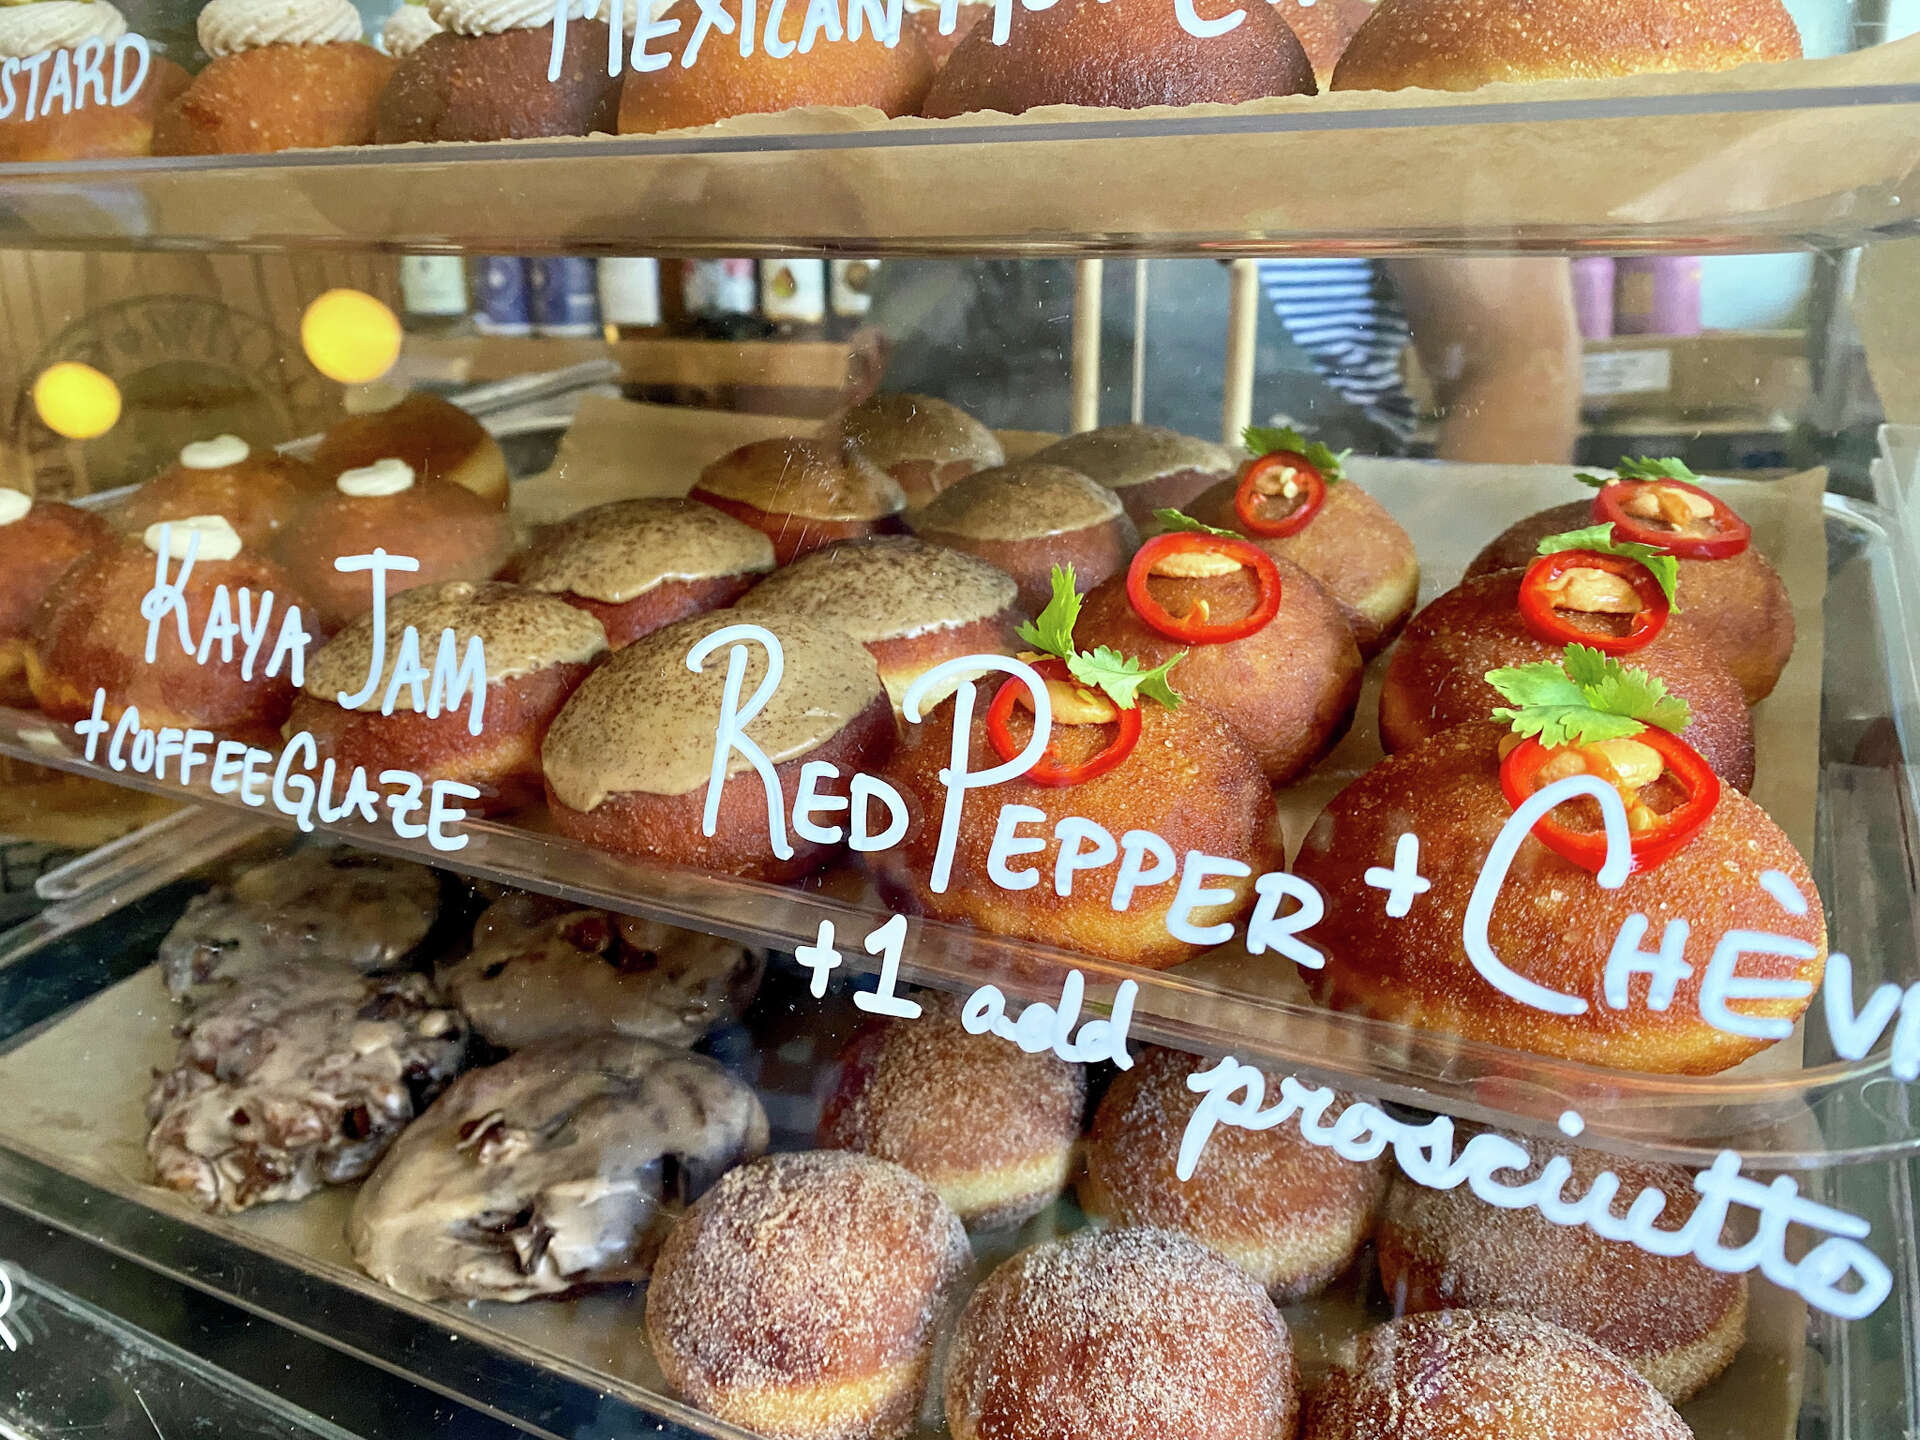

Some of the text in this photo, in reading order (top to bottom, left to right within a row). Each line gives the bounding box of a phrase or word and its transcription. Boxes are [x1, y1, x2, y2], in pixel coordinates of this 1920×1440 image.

[0, 32, 150, 121] STARD
[547, 0, 904, 82] MEXICAN
[141, 523, 487, 737] KAYA JAM
[686, 624, 909, 861] RED
[902, 655, 1325, 969] PEPPER
[794, 913, 1892, 1318] +1 add prosciutto
